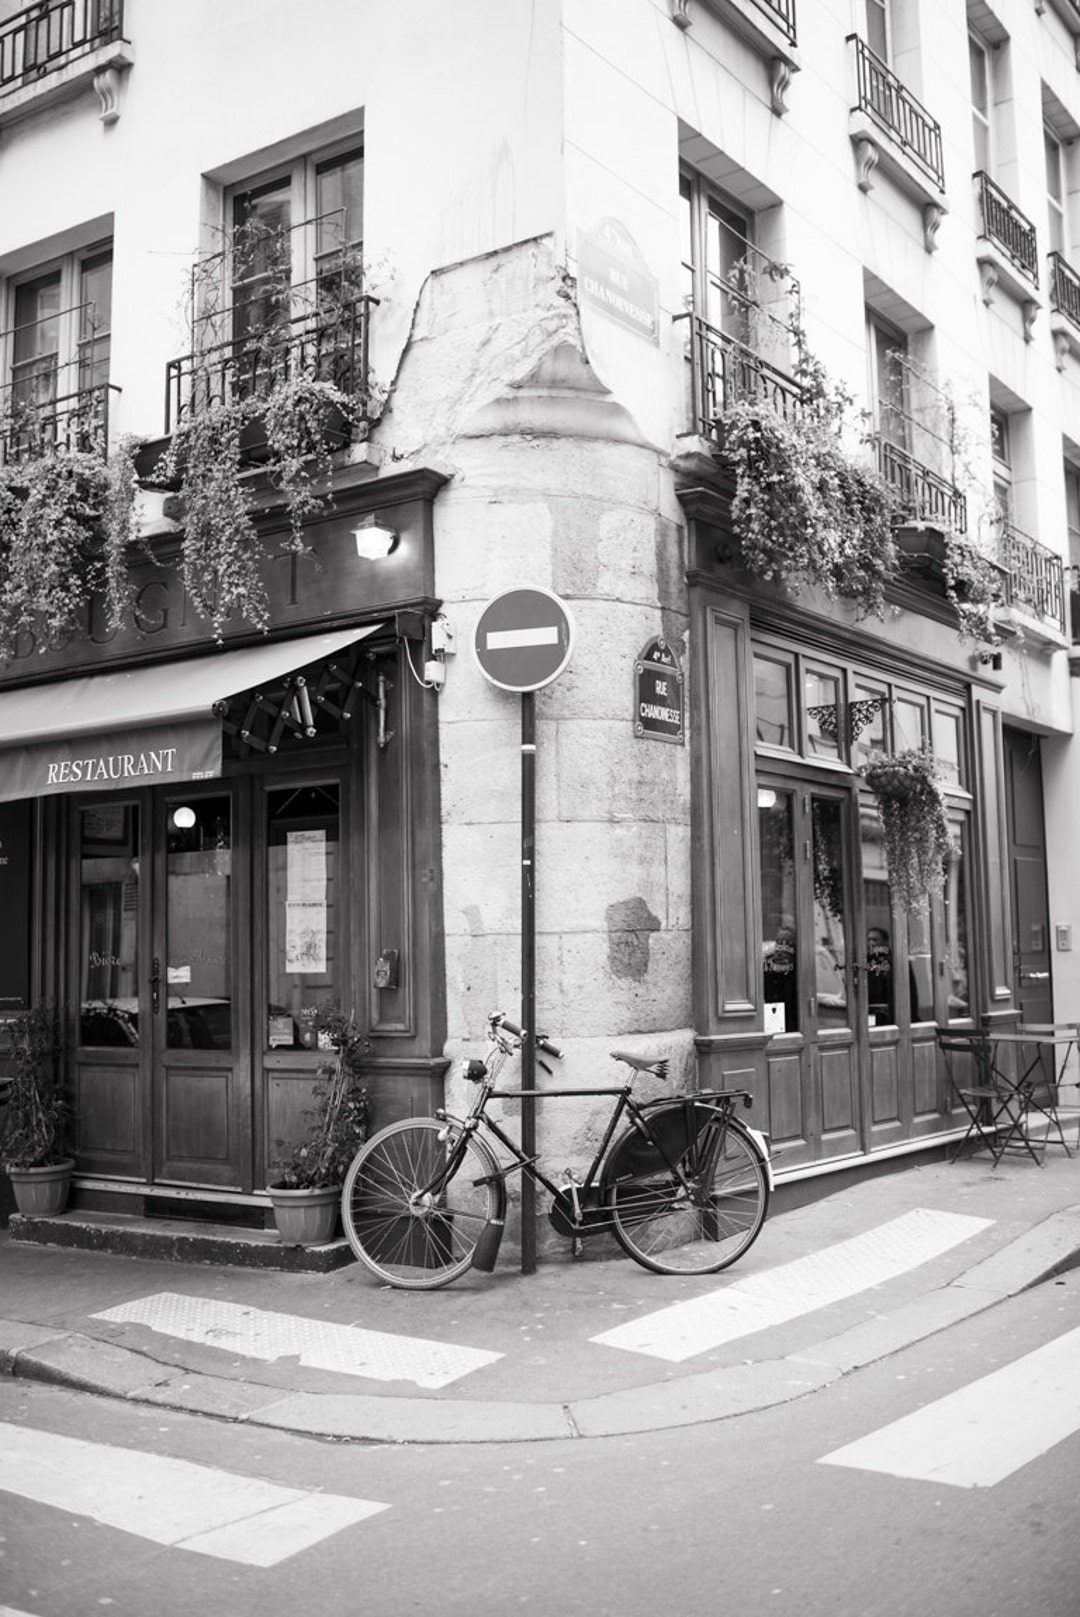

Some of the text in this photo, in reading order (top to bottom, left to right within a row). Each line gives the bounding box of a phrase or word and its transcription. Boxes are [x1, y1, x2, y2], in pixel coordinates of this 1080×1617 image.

[655, 680, 668, 696] RUE
[640, 703, 680, 724] CHANOINESSE
[47, 748, 176, 784] RESTAURANT
